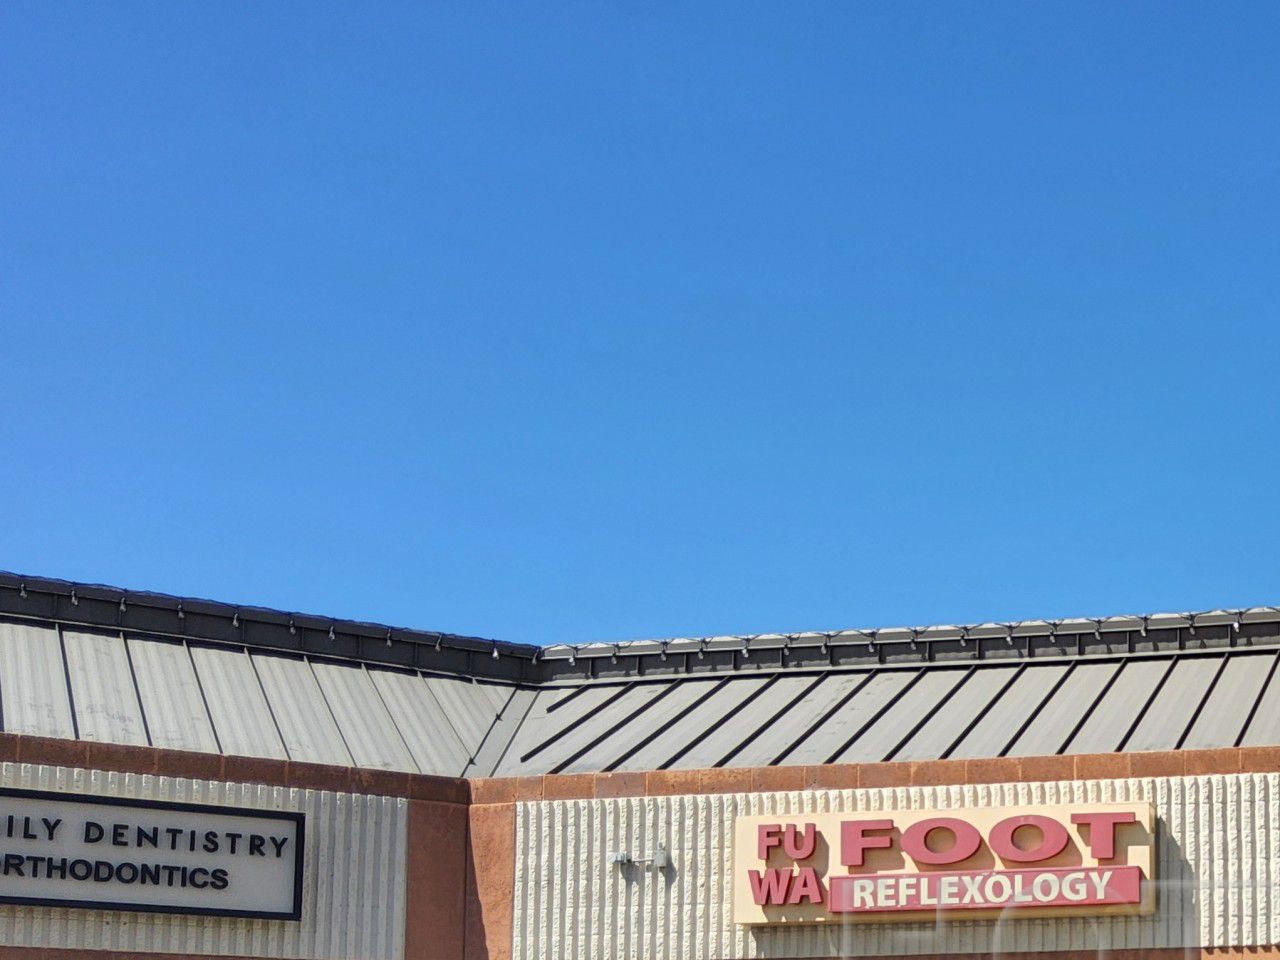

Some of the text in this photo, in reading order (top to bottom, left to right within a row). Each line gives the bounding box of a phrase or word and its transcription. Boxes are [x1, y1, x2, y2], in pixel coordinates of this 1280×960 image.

[84, 821, 289, 858] DENTISTRY
[757, 811, 1137, 867] FU FOOT
[0, 852, 230, 891] RTHODONTICS
[748, 867, 1113, 909] WA REFLEXOLOGY
